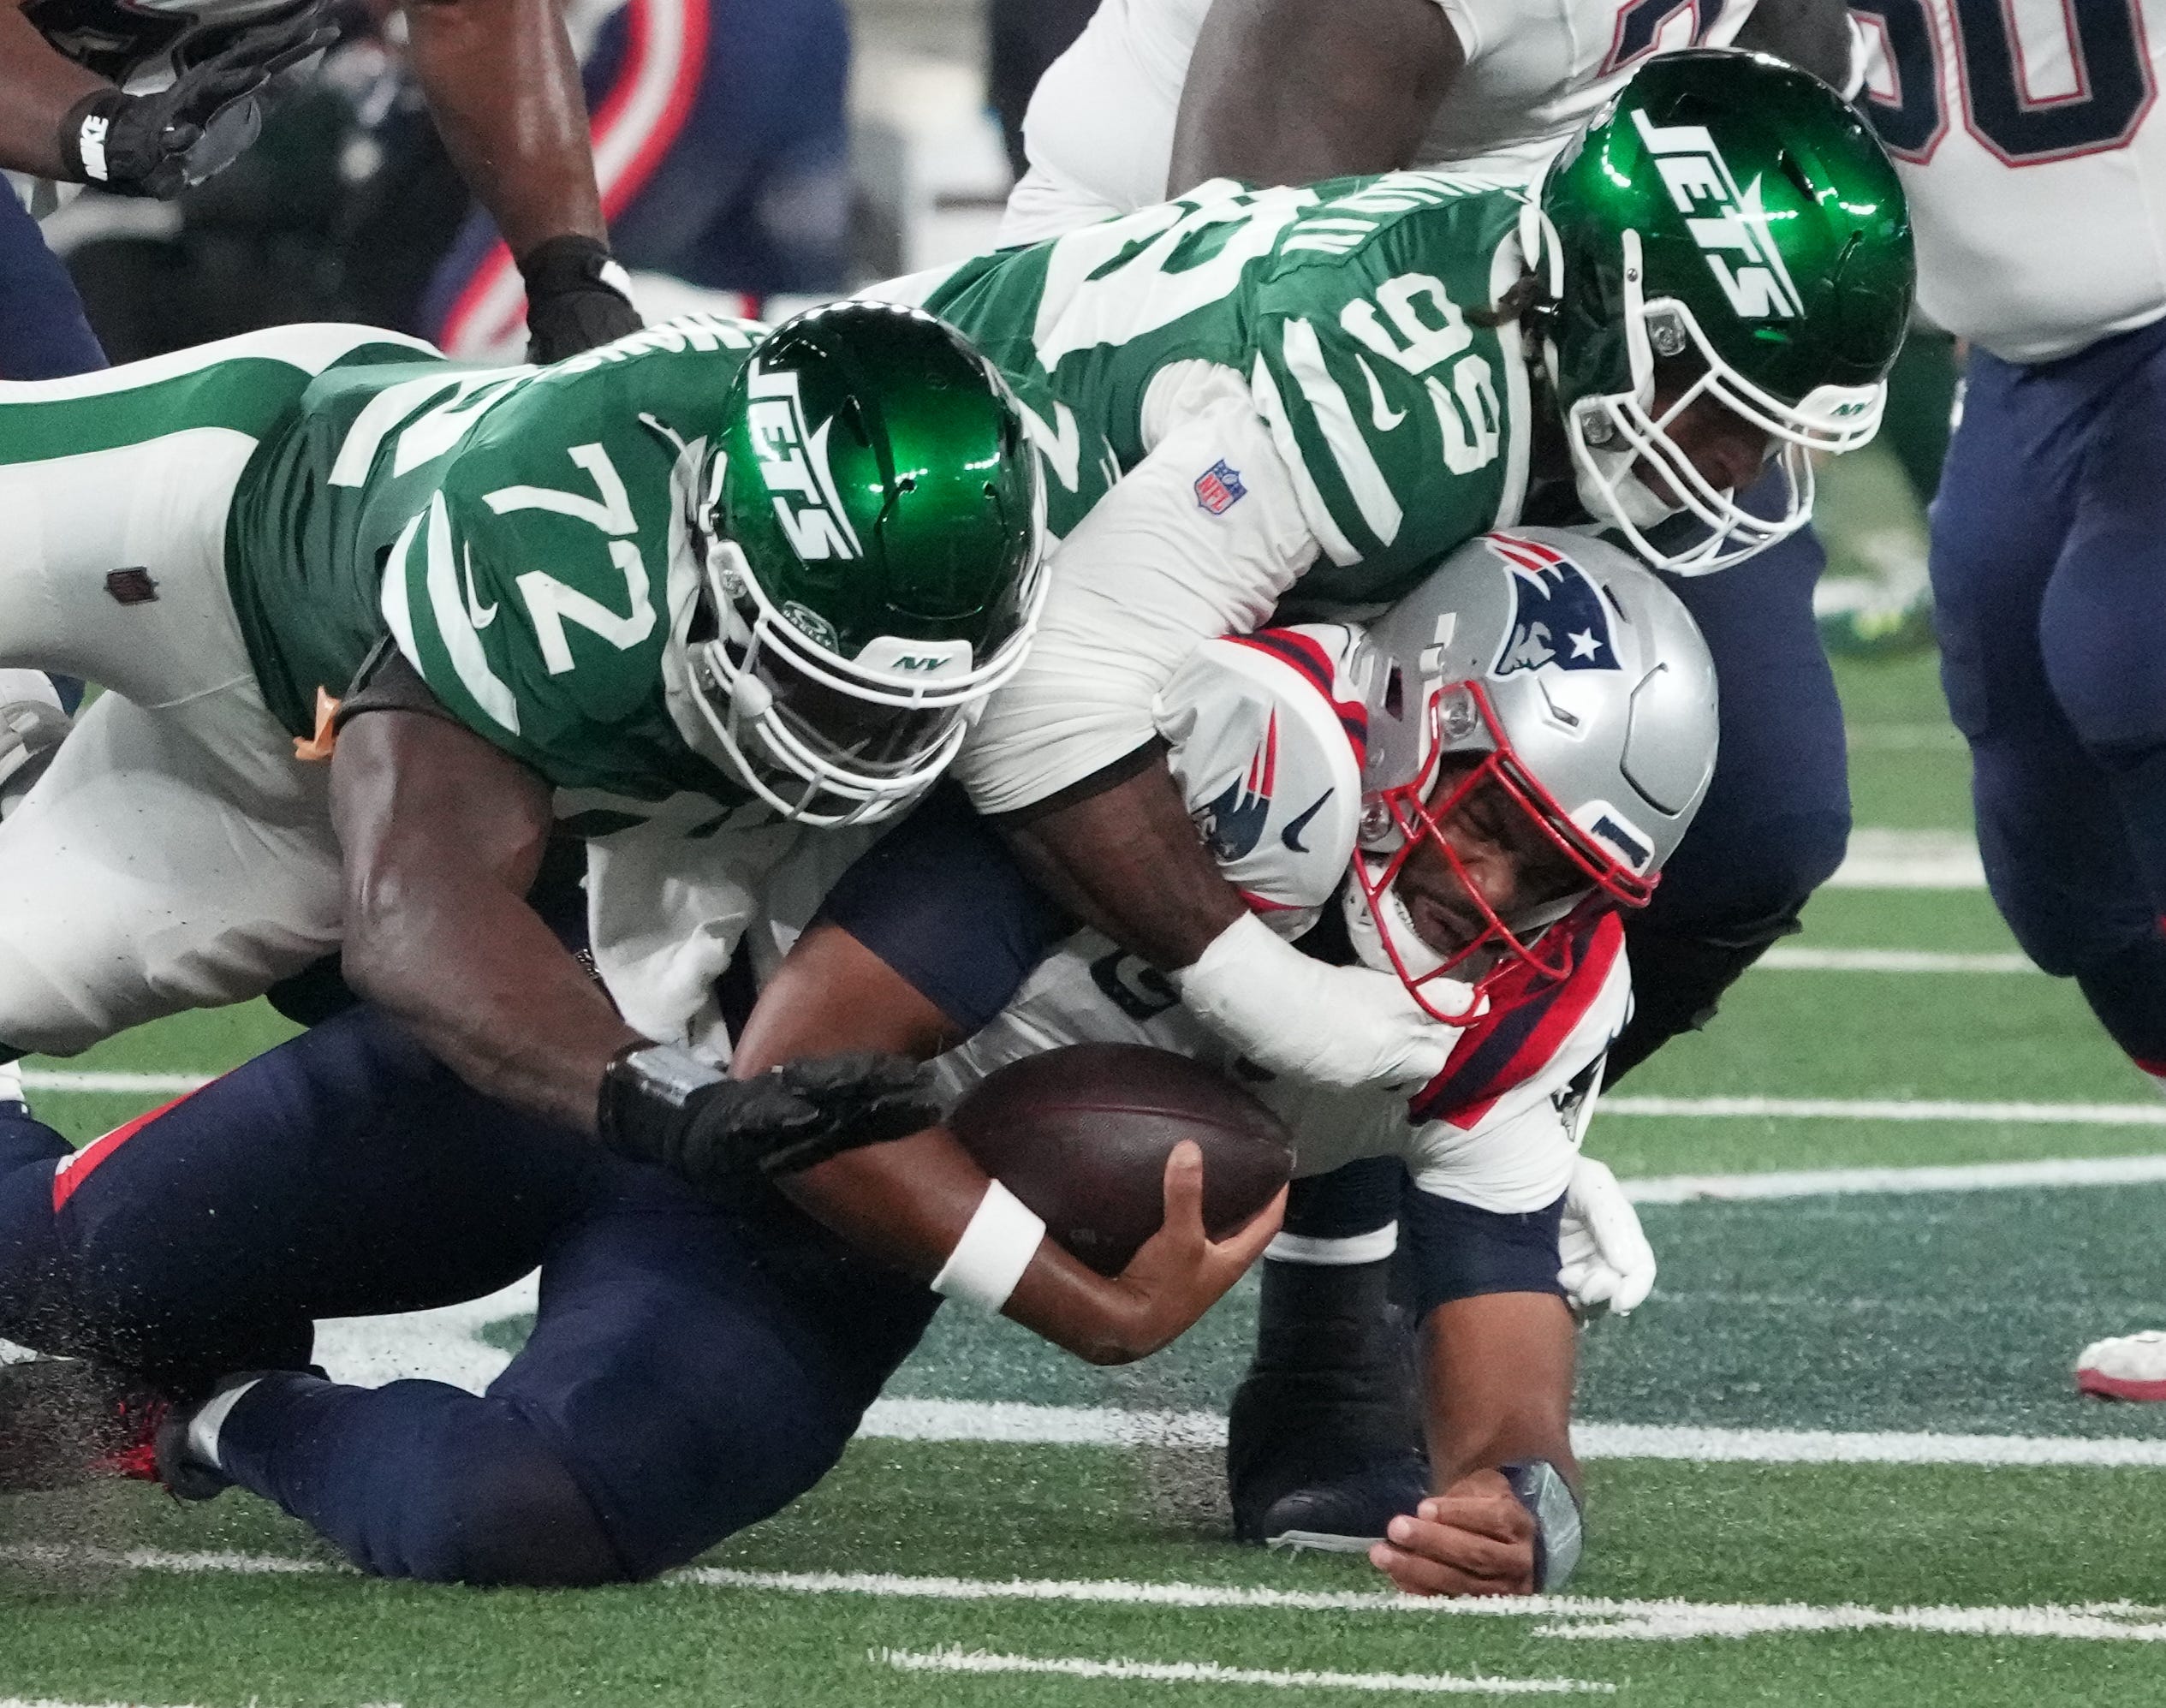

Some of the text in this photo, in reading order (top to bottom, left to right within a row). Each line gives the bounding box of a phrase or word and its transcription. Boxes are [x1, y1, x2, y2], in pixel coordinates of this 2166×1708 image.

[80, 113, 110, 182] NIKE
[1630, 108, 1806, 319] JETS
[747, 356, 865, 562] JETS
[1340, 271, 1501, 476] 99
[481, 442, 658, 675] 72
[1197, 472, 1231, 513] NFL
[890, 654, 953, 672] NY
